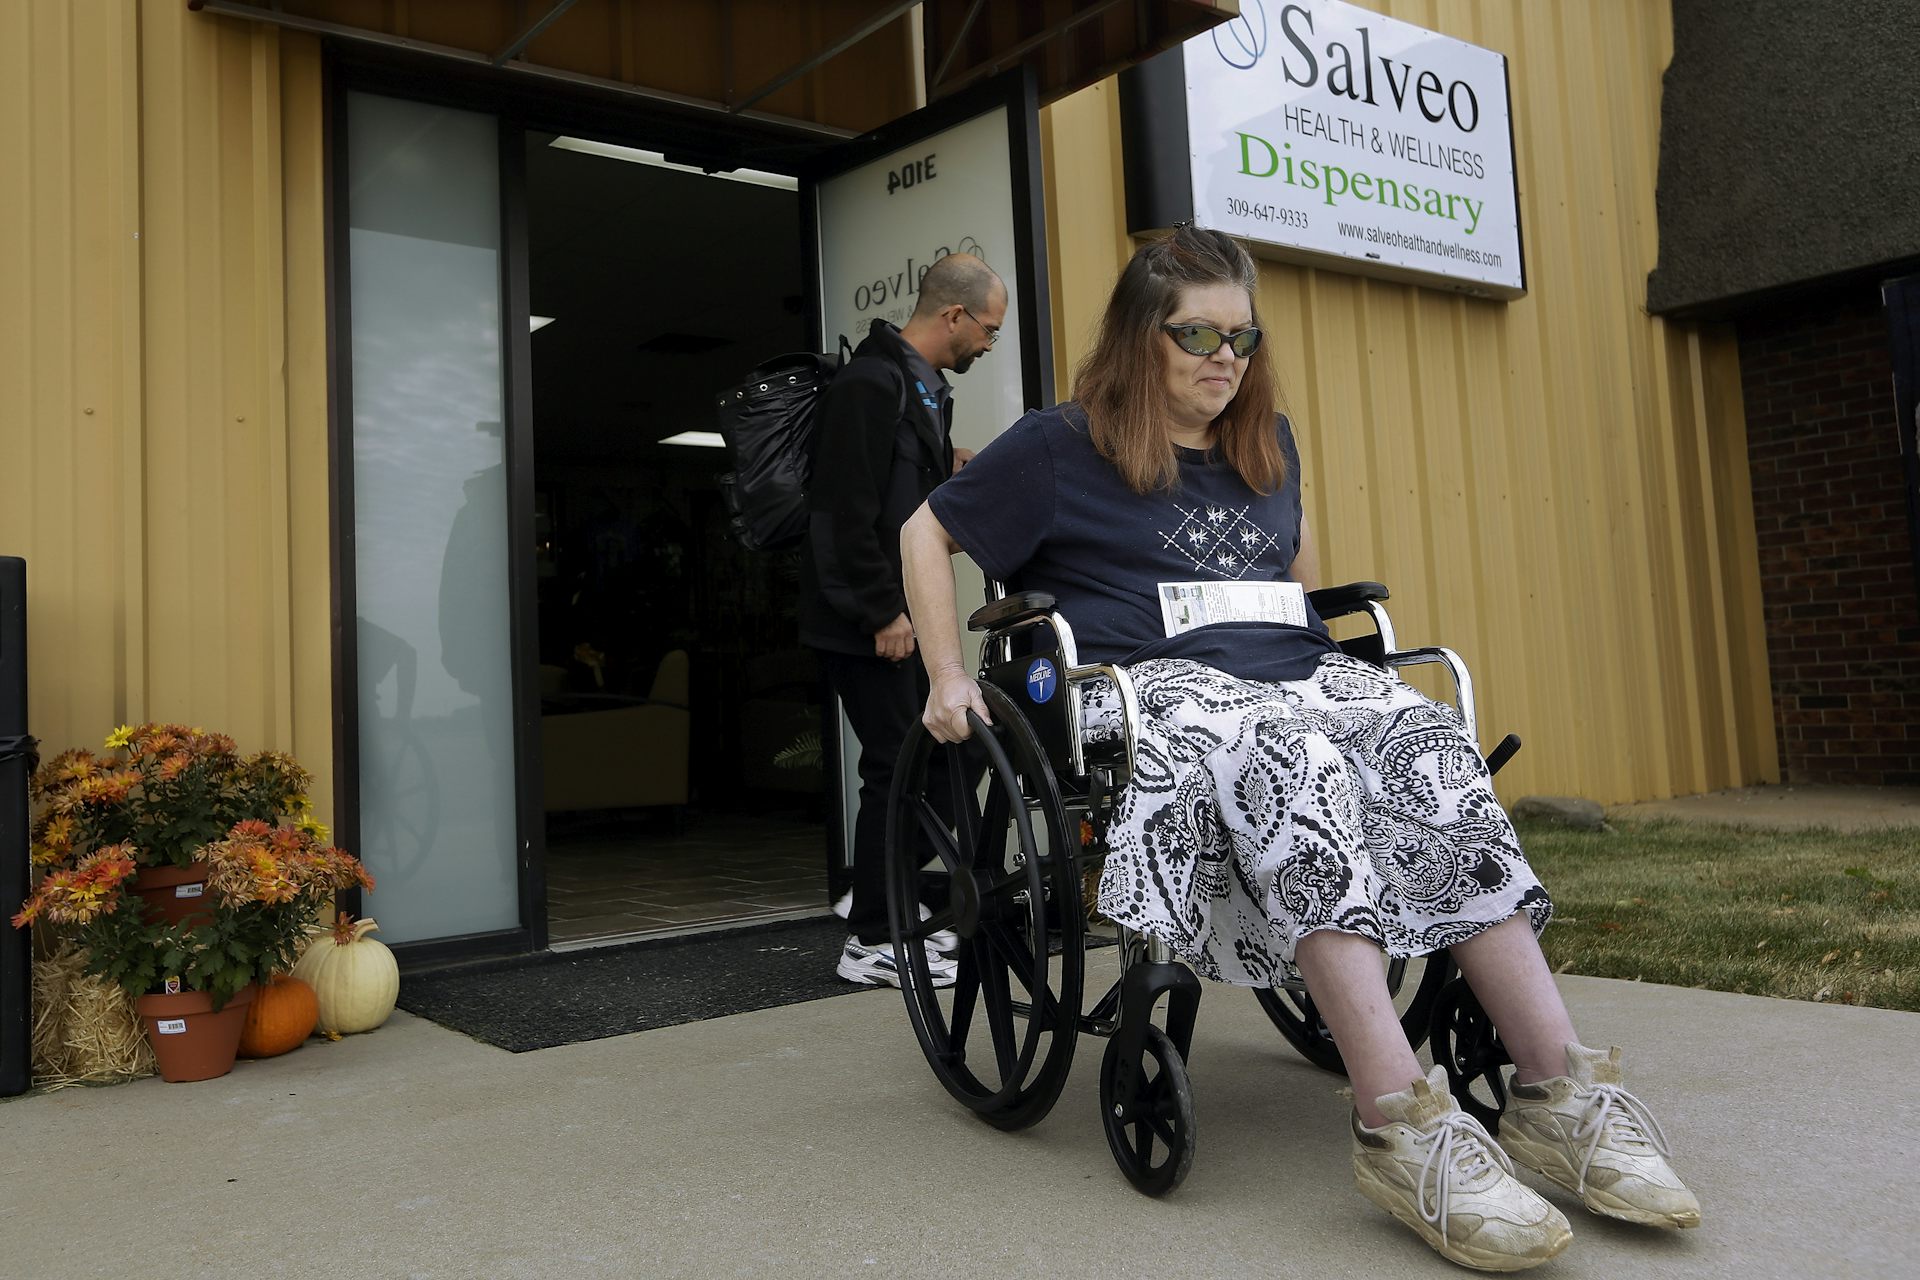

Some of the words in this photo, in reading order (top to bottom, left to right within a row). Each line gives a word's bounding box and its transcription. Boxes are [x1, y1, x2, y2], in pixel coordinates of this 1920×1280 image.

[1280, 4, 1479, 133] Salveo
[1284, 103, 1365, 149] HEALTH
[1371, 127, 1384, 154] &
[1388, 131, 1485, 179] WELLNESS
[1234, 131, 1484, 235] Dispensary
[1227, 197, 1309, 229] 309-647-9333
[1337, 220, 1502, 268] www.salveohealthandwellness.com
[1029, 668, 1052, 683] MEDLINE
